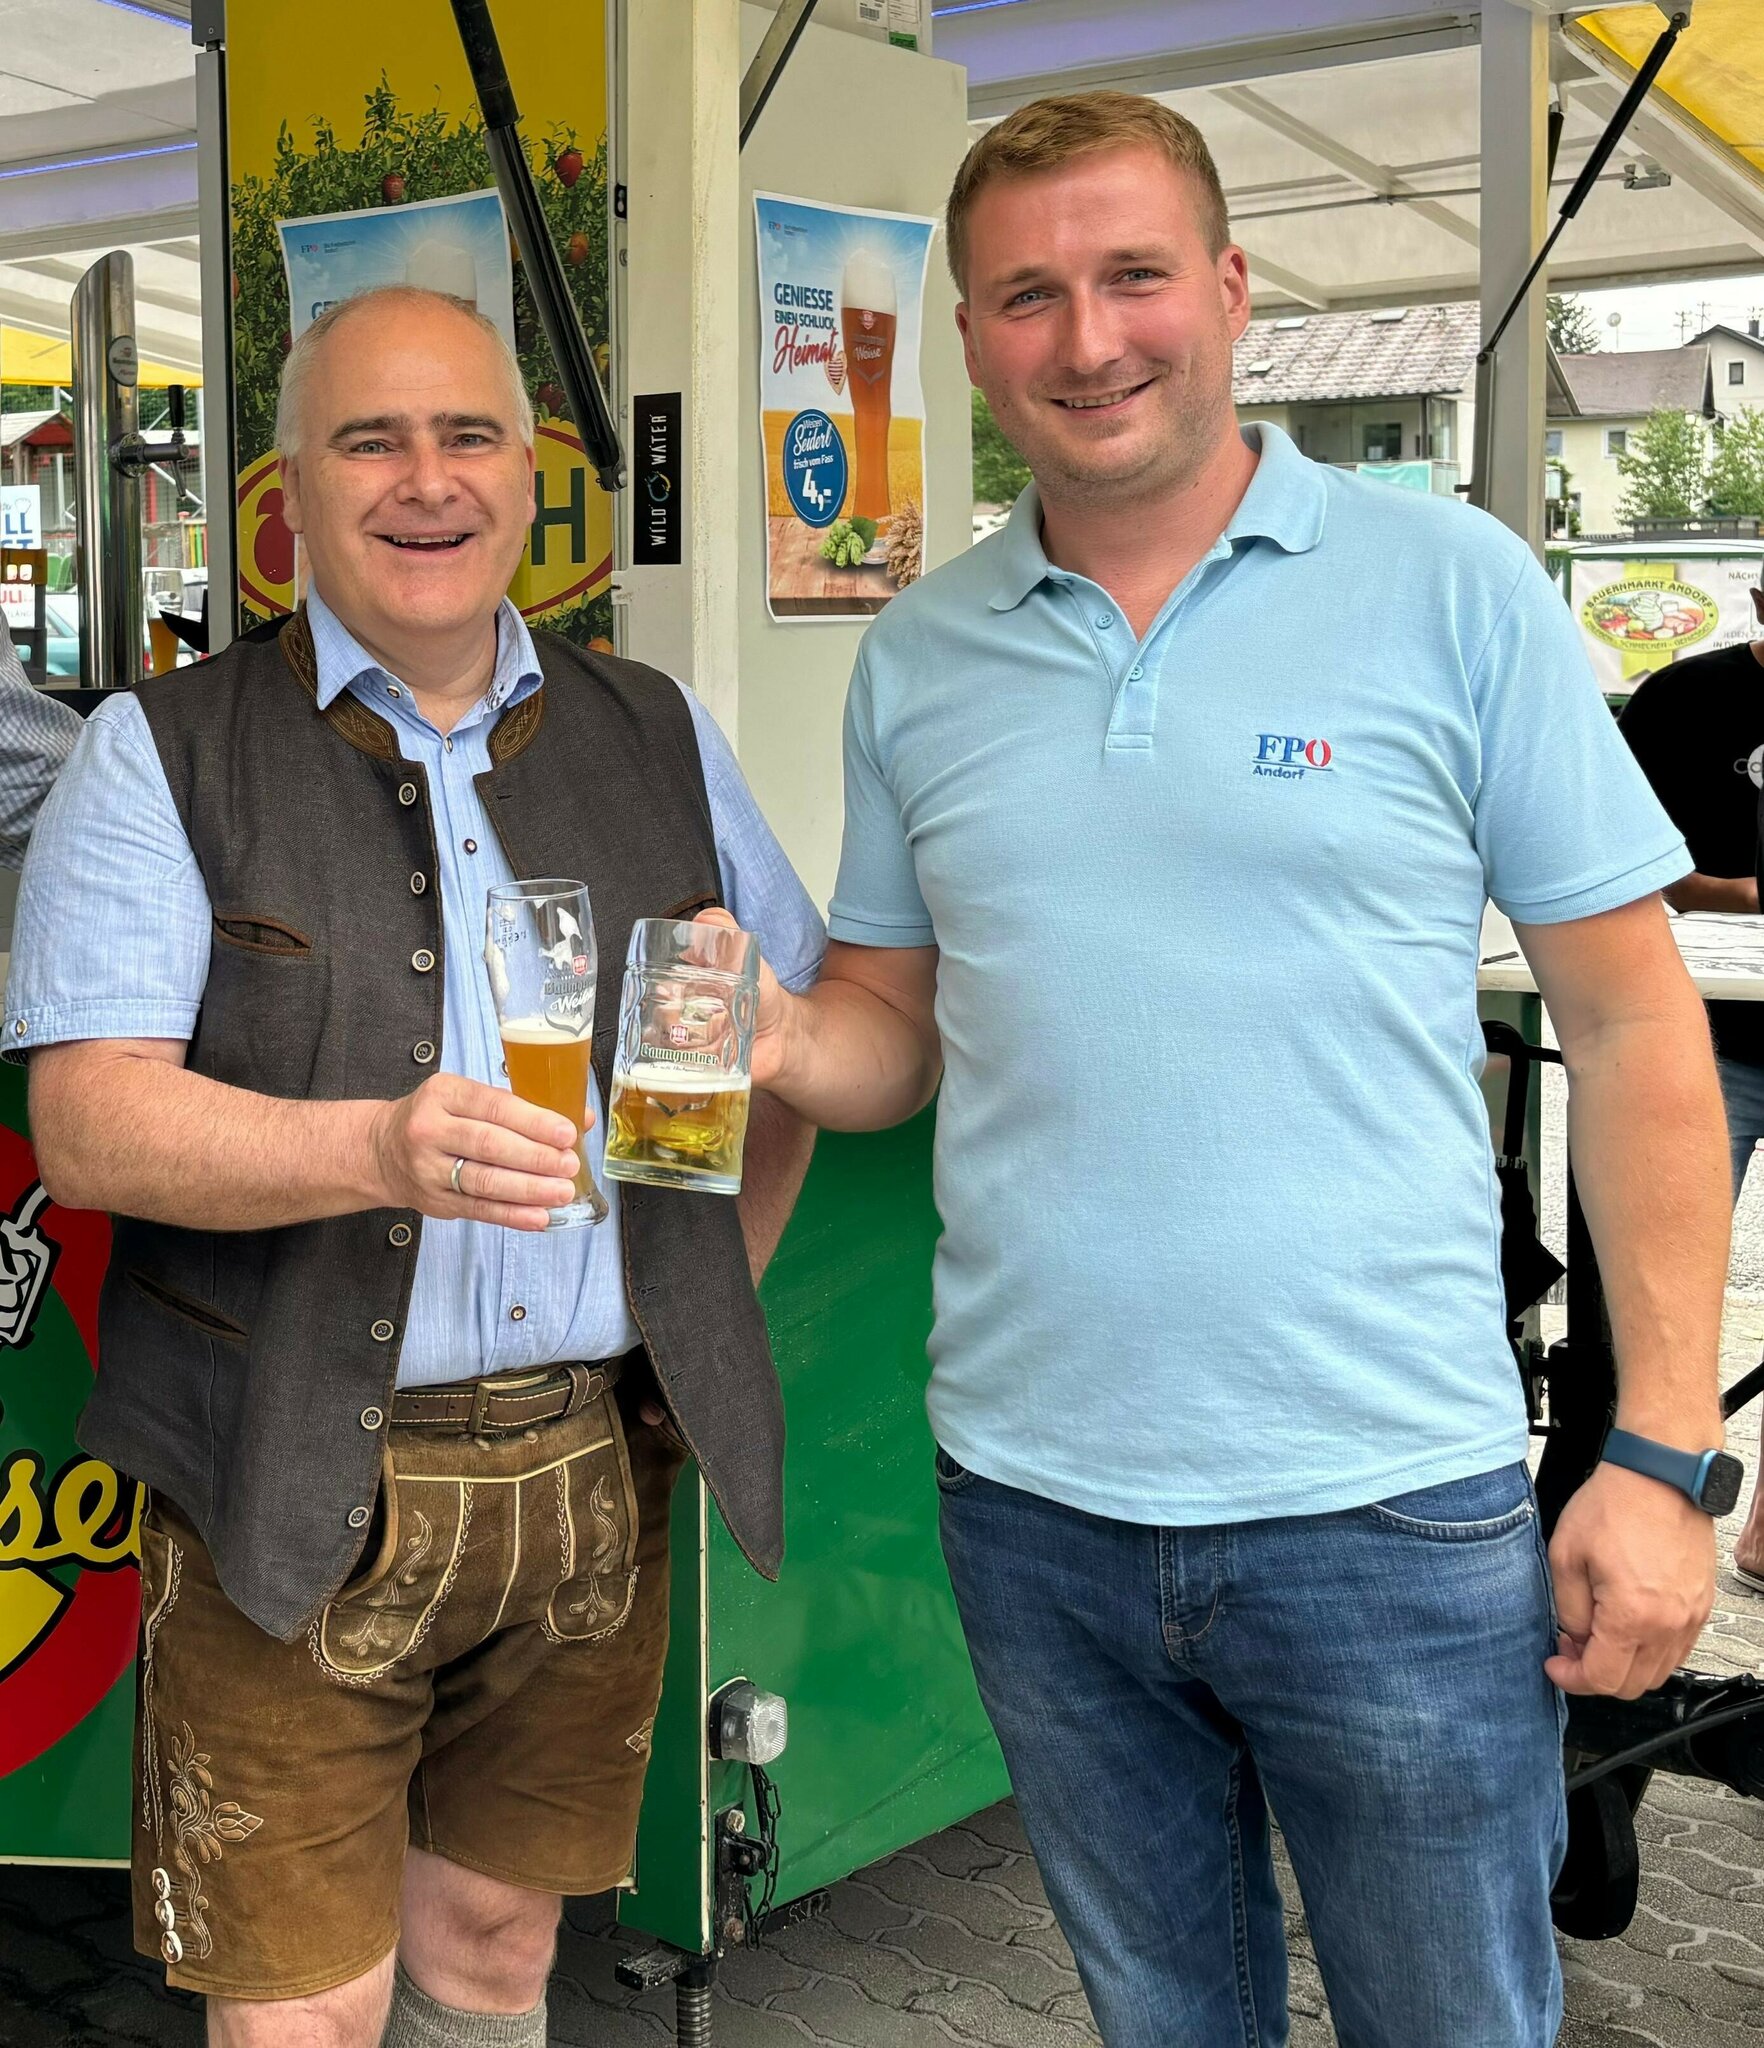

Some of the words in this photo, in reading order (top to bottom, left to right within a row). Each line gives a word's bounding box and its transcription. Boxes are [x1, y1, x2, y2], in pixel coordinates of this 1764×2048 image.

[774, 282, 834, 311] GENIESSE
[775, 310, 797, 326] EINEN
[799, 314, 836, 330] SCHLUCK
[773, 326, 839, 374] Heimat
[650, 415, 667, 466] WATER
[793, 423, 832, 456] Seiderl
[821, 454, 834, 464] Fass
[651, 508, 667, 546] WILD
[1586, 579, 1665, 609] BAUERNMARKT
[1669, 582, 1714, 609] ANDORF
[1252, 765, 1306, 780] Andorf
[640, 1042, 720, 1067] Baumgartner
